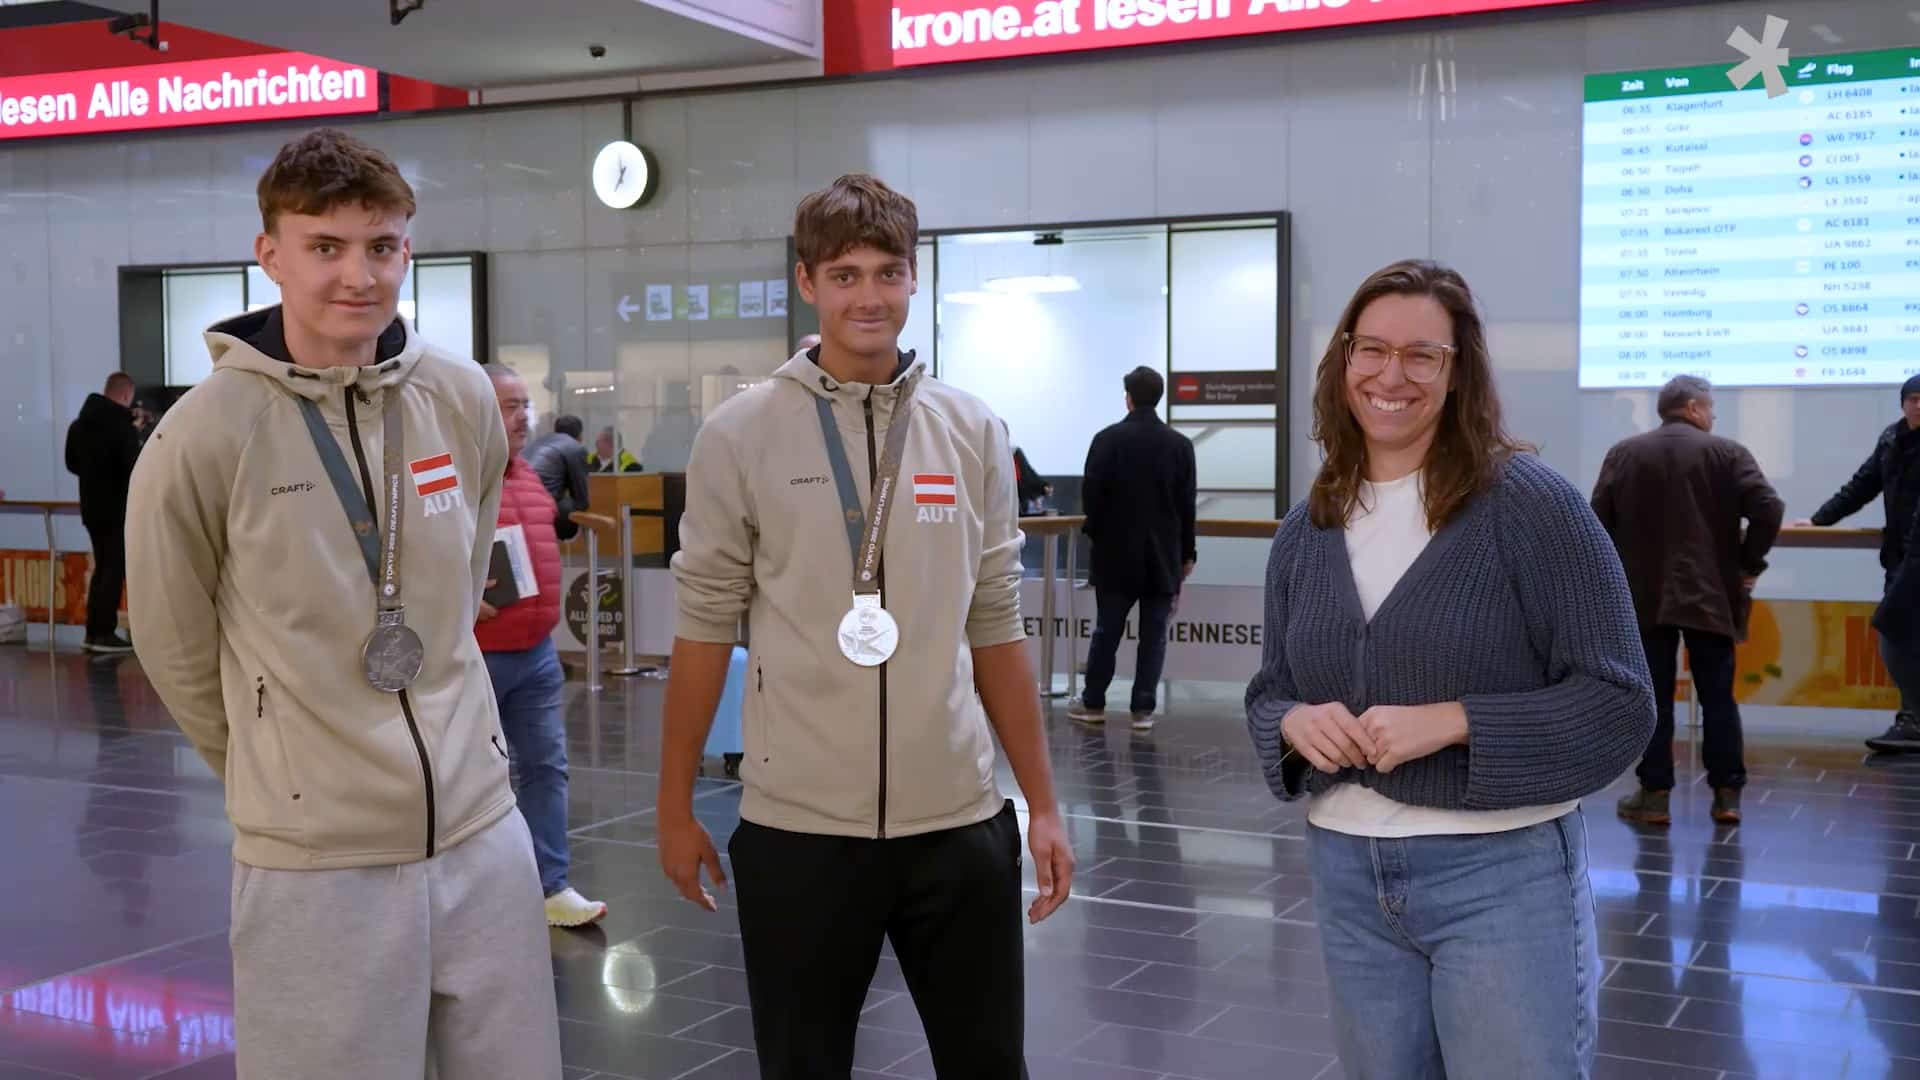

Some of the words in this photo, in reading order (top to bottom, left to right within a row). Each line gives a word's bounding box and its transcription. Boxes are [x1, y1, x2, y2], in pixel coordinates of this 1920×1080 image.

[891, 0, 1080, 49] krone.at
[1621, 80, 1644, 92] Zeit
[1665, 77, 1689, 88] Von
[1826, 64, 1853, 76] Flug
[87, 81, 149, 119] Alle
[158, 65, 366, 113] Nachrichten
[1666, 100, 1723, 112] Klagenfurt
[1665, 184, 1693, 194] Doha
[1665, 224, 1711, 235] Bukarest
[1841, 260, 1861, 270] 100
[1664, 287, 1706, 298] Venedig
[1664, 308, 1712, 319] Hamburg
[1662, 350, 1712, 361] Stuttgart
[790, 477, 820, 486] CRAFT
[271, 483, 305, 496] CRAFT
[423, 490, 463, 518] AUT
[916, 506, 958, 523] AUT
[865, 543, 876, 568] TOKYO
[386, 552, 395, 580] TOKYO
[1169, 622, 1262, 645] IENNESE
